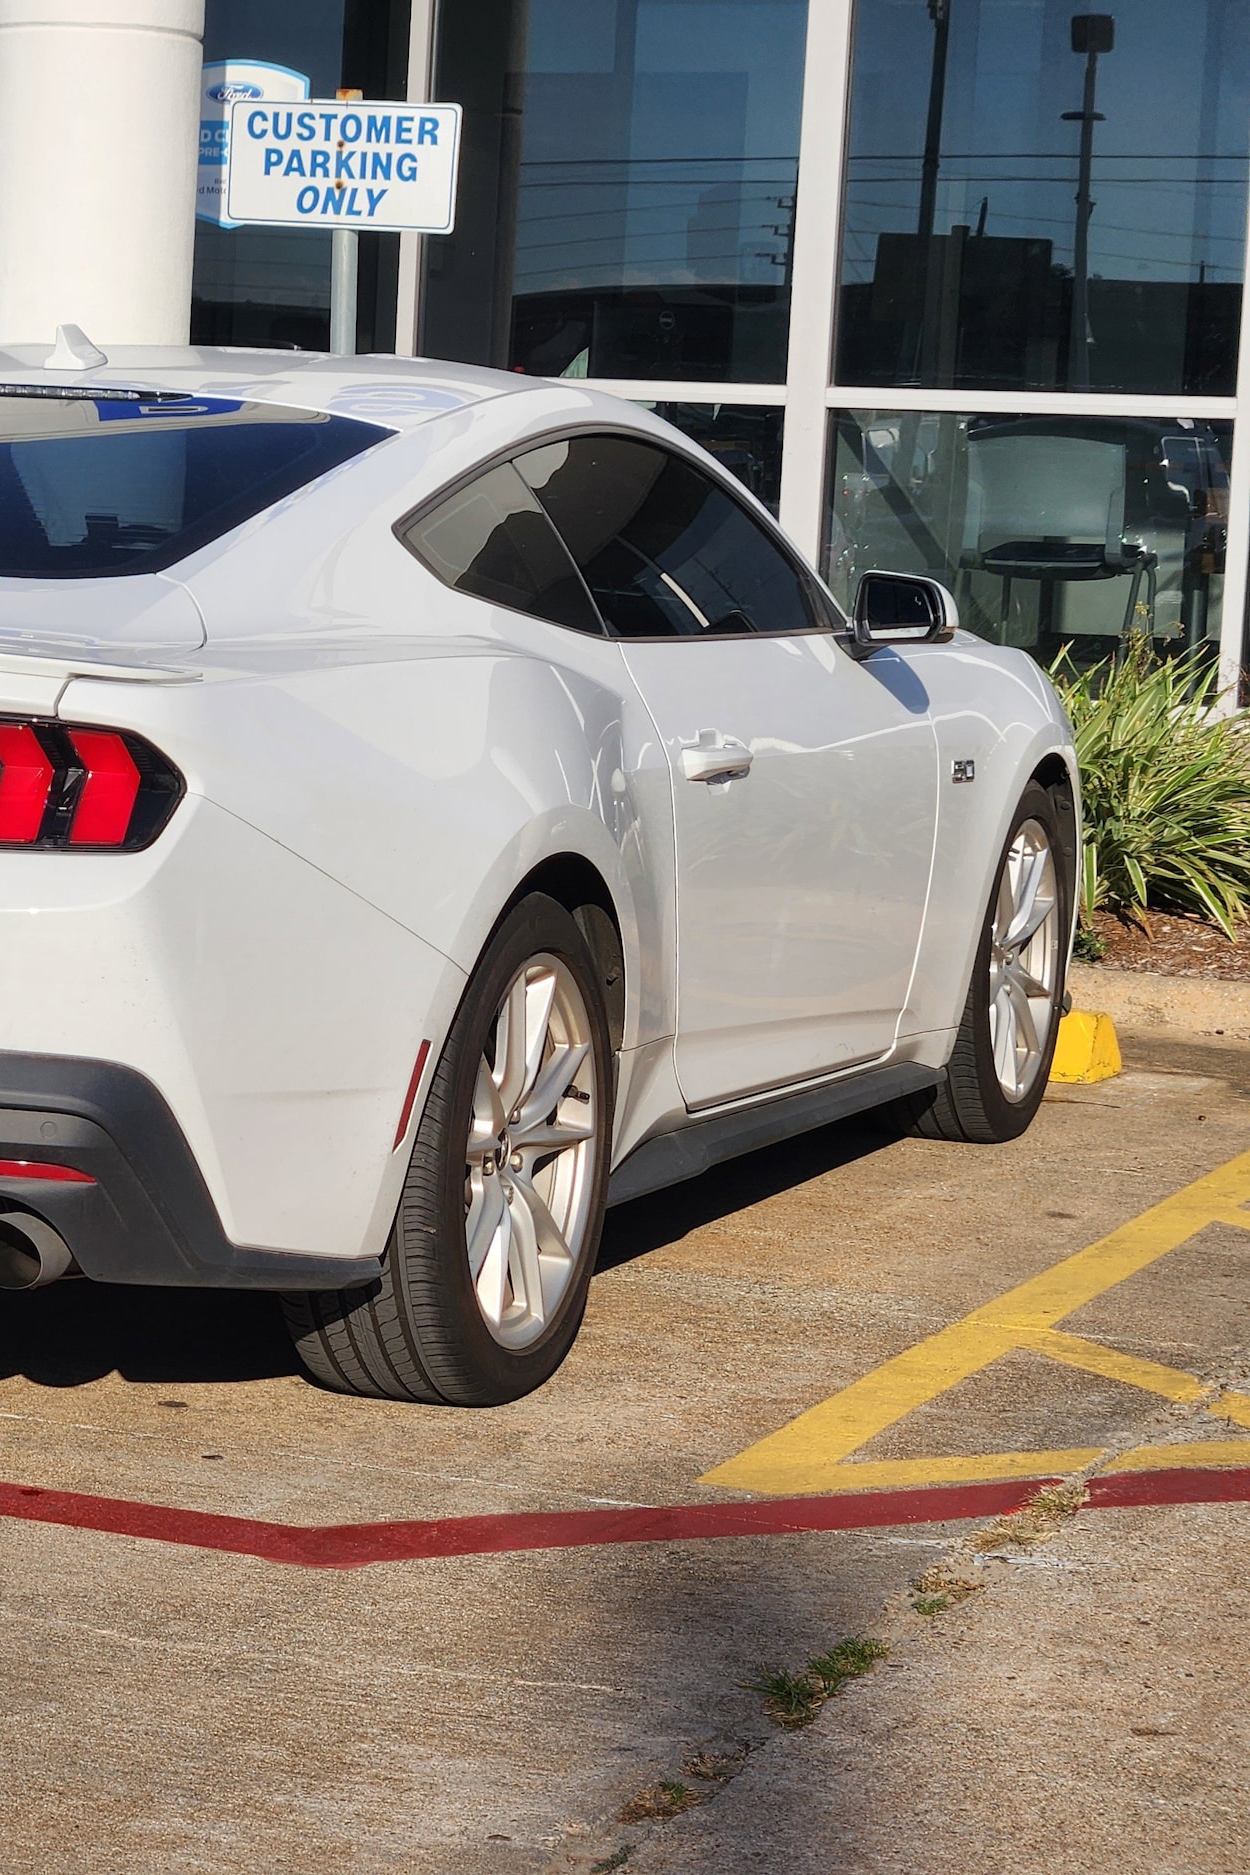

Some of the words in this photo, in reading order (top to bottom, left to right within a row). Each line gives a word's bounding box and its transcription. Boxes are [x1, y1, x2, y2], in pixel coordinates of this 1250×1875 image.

[247, 111, 440, 146] CUSTOMER
[263, 148, 418, 182] PARKING
[296, 185, 388, 217] ONLY
